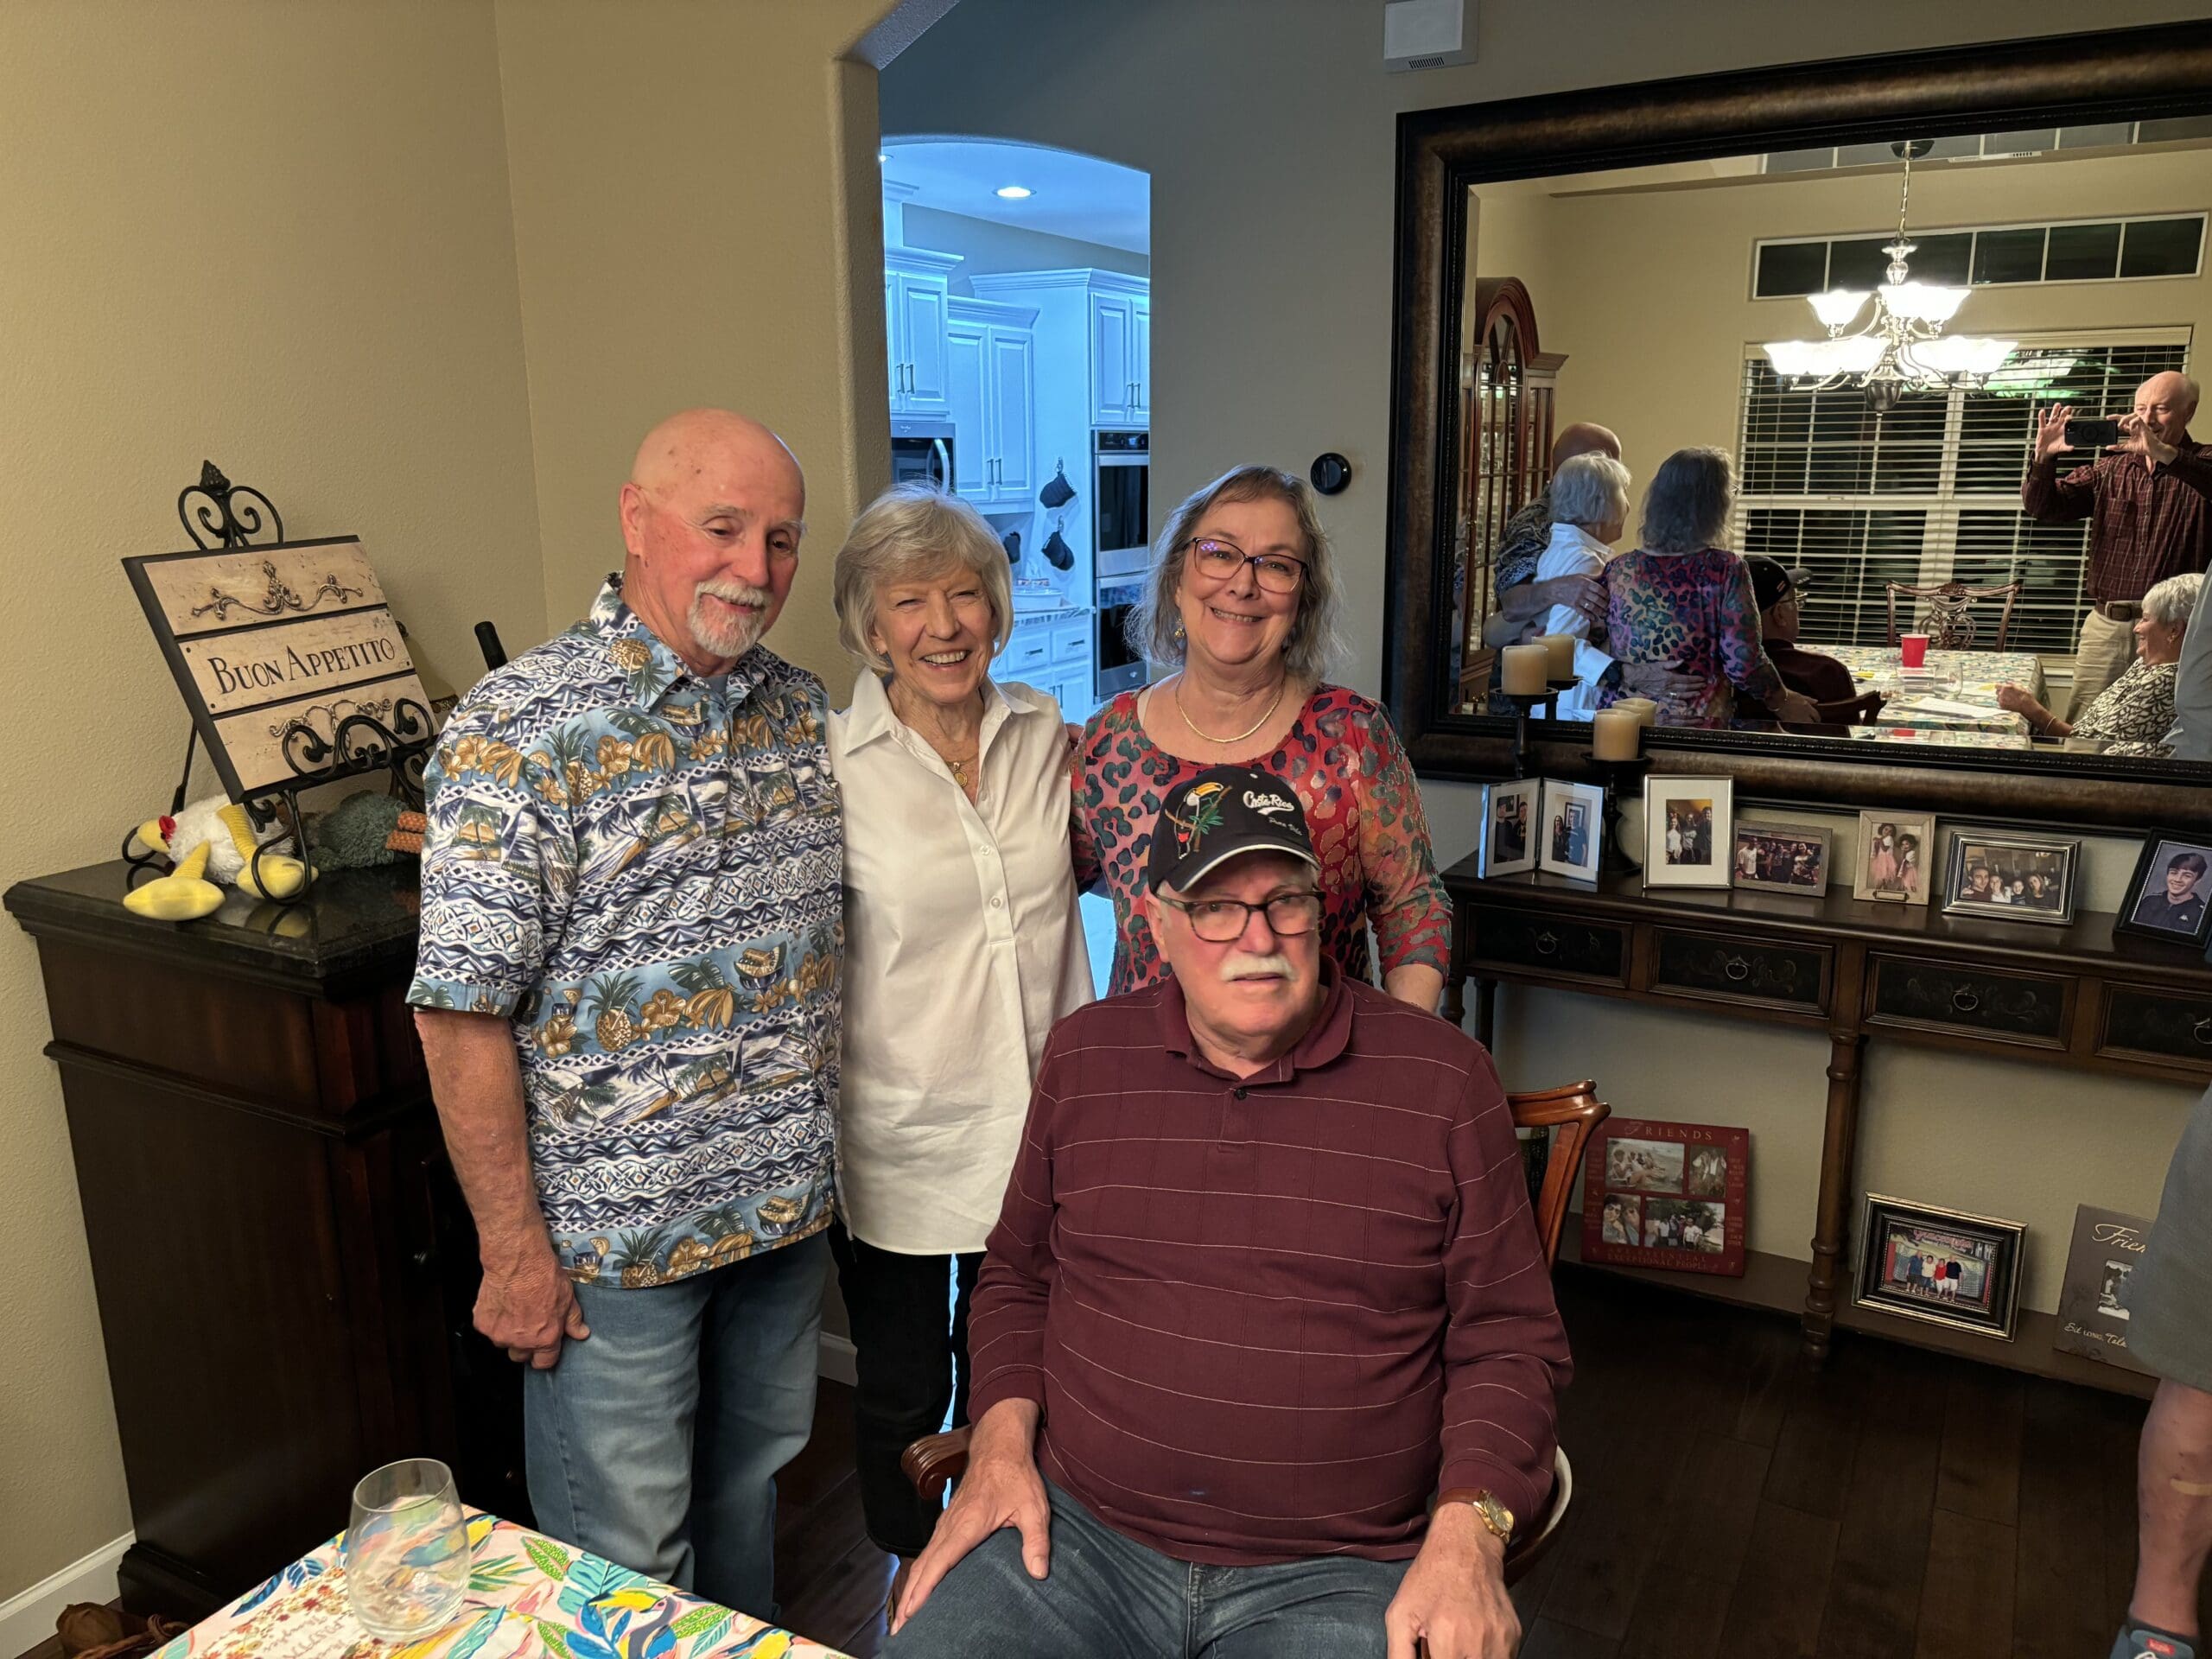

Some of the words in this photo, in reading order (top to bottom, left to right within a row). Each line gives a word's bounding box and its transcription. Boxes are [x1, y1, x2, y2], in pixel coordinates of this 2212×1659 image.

[207, 657, 284, 694] BUON
[287, 639, 395, 681] APPETITO
[1243, 791, 1271, 809] Costa
[1269, 794, 1294, 811] Rica
[1624, 1122, 1713, 1141] FRIENDS
